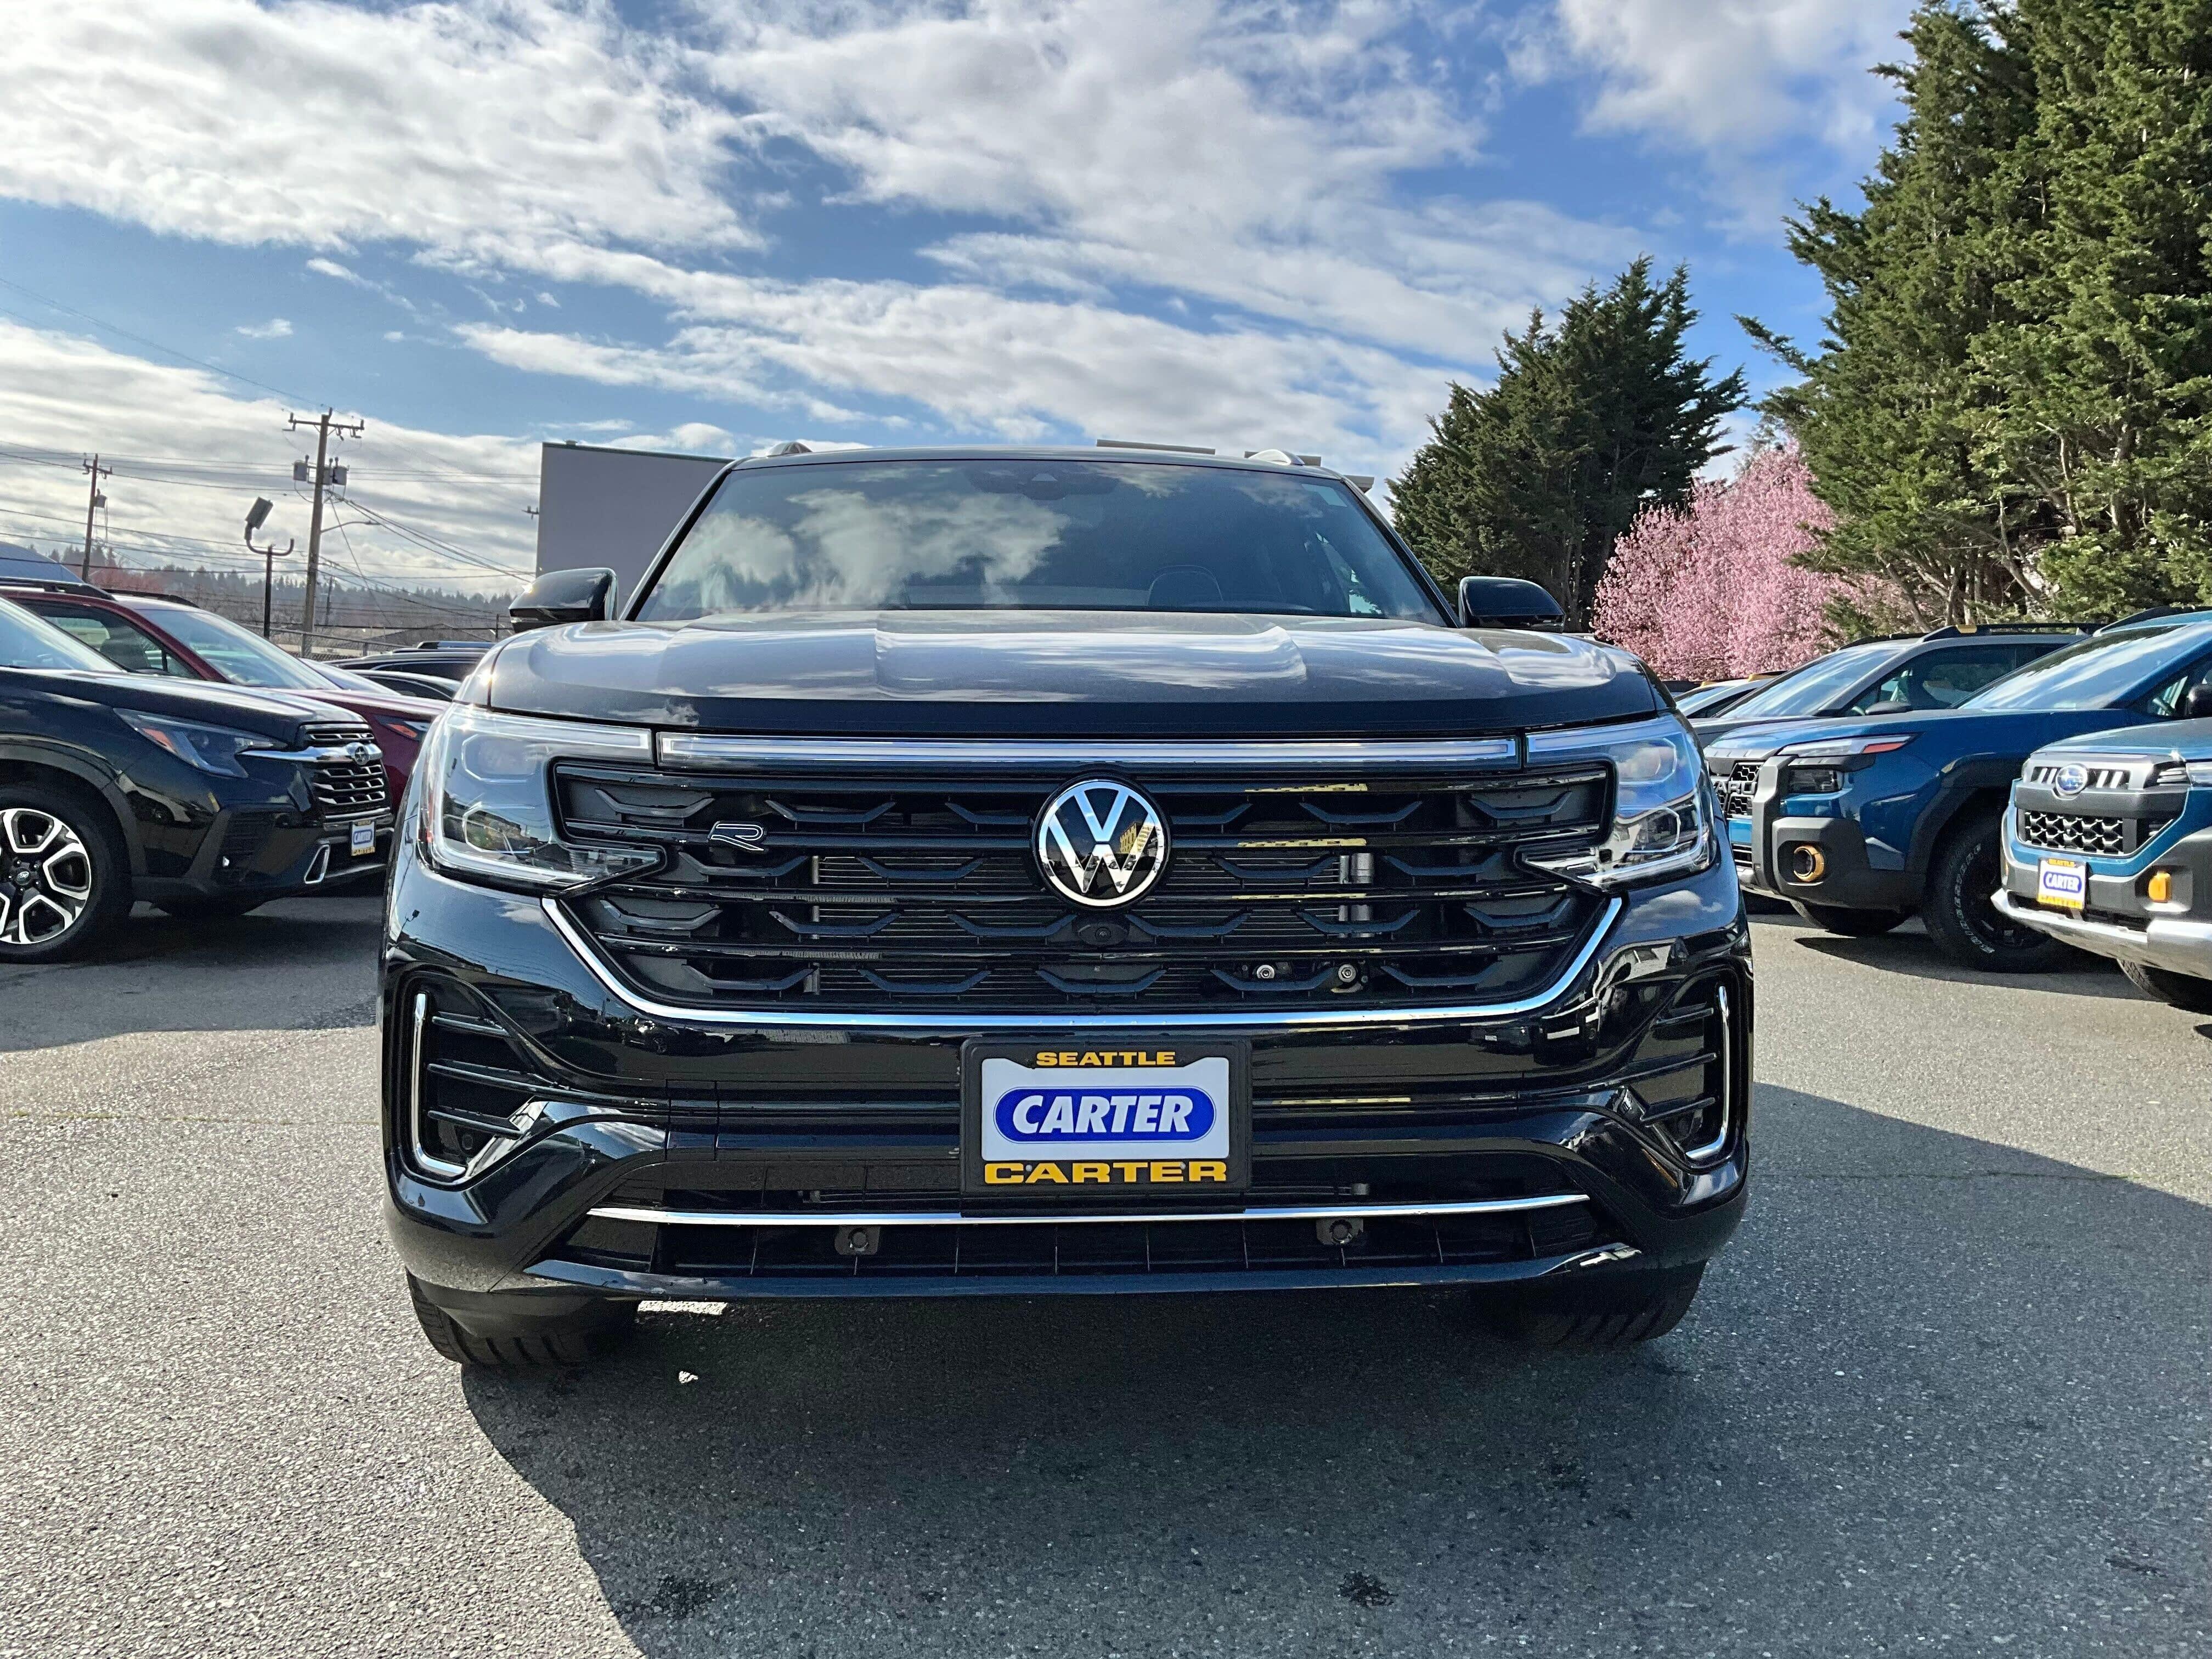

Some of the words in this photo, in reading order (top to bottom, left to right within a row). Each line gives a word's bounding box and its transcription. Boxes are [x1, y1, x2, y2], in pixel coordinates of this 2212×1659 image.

[1712, 780, 1757, 795] ARU
[2045, 873, 2080, 891] CARTER
[2038, 895, 2083, 909] CARTER
[1036, 1052, 1176, 1066] SEATTLE
[1012, 1095, 1193, 1134] CARTER
[984, 1161, 1227, 1184] CARTER
